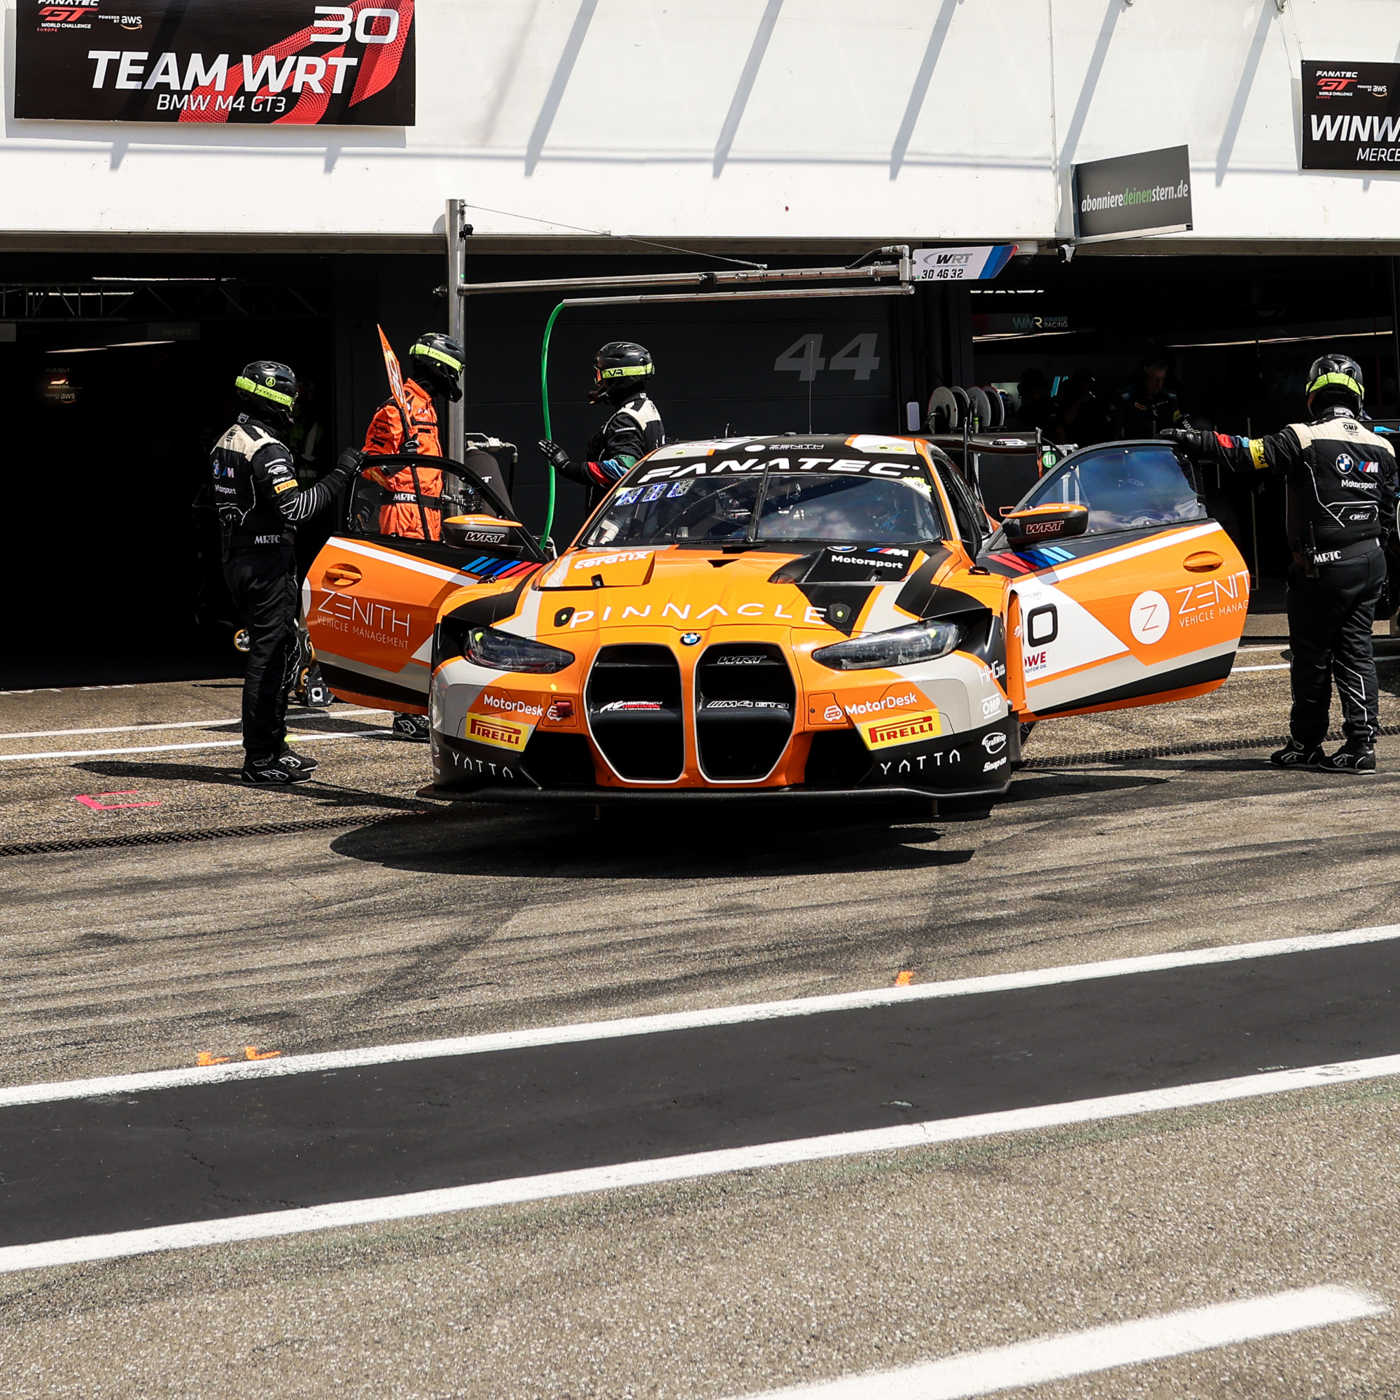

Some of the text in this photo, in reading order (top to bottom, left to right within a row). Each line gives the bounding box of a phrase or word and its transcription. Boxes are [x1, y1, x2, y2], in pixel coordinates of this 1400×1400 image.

[121, 15, 143, 25] aws
[310, 5, 400, 45] 30
[87, 50, 359, 94] TEAM WRT
[1315, 70, 1358, 78] FANATEC
[157, 94, 286, 113] BMW M4 GT3
[1081, 179, 1189, 213] abonnieredeinenstern.de
[936, 252, 974, 264] WRT
[921, 269, 964, 279] 30 46 32
[773, 333, 881, 382] 44
[637, 457, 912, 484] FANATEC
[1341, 479, 1377, 490] Motorsport
[465, 531, 505, 544] WRT
[1025, 520, 1065, 534] WRT
[831, 555, 904, 569] Motorsport
[1313, 550, 1342, 564] MRTC
[1176, 569, 1250, 615] ZENIT
[318, 587, 411, 638] ZENITH
[569, 602, 828, 629] PINNACLE
[1179, 609, 1214, 628] VEHICLE
[317, 615, 409, 649] VEHICLE MANAGEMENT
[717, 654, 768, 665] WRT
[483, 693, 544, 717] MotorDesk
[844, 692, 918, 716] MotorDesk
[470, 719, 522, 745] PIRELLI
[868, 716, 933, 744] PIRELLI
